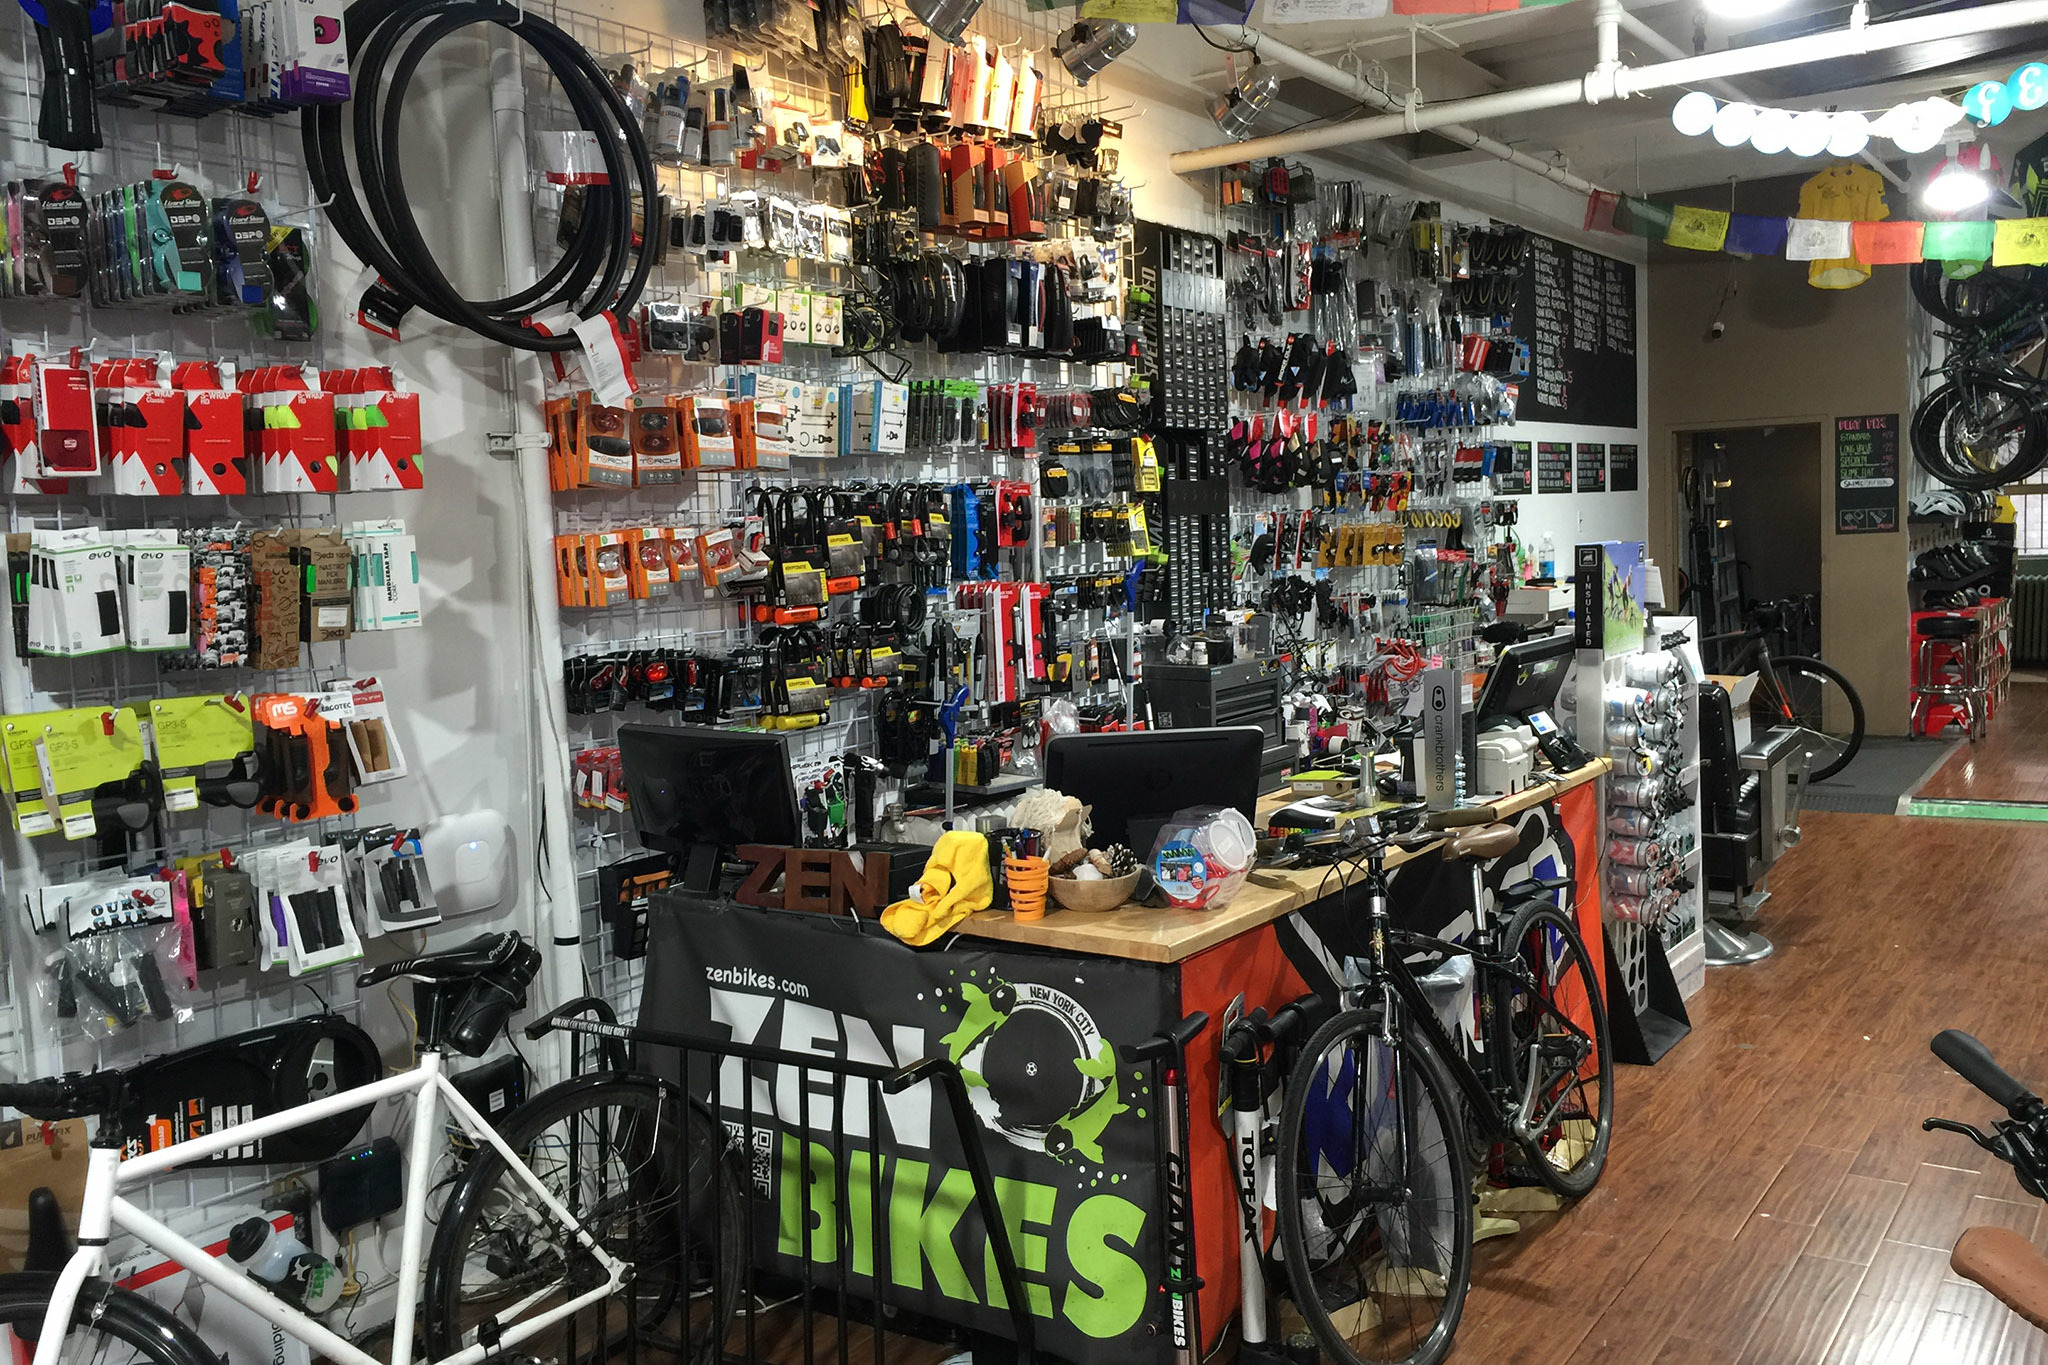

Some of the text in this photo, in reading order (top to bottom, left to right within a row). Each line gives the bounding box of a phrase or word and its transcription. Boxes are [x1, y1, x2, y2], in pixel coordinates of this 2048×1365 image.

[701, 439, 730, 447] TORCH
[760, 442, 787, 450] TORCH
[593, 455, 630, 465] TORCH
[88, 551, 112, 560] evo
[141, 552, 164, 560] evo
[384, 561, 393, 602] HANDLEBAR
[321, 702, 352, 712] ERGOTEC
[157, 720, 187, 730] GP3-S
[50, 740, 79, 752] GP3-S
[1434, 715, 1446, 792] crankbrothers
[736, 844, 890, 919] ZEN
[706, 966, 810, 998] zenbikes.com
[1030, 986, 1095, 1036] NEW YORK CITY
[706, 986, 932, 1150] ZEN
[1238, 1130, 1258, 1245] TOPEAK
[778, 1131, 1147, 1338] BIKES
